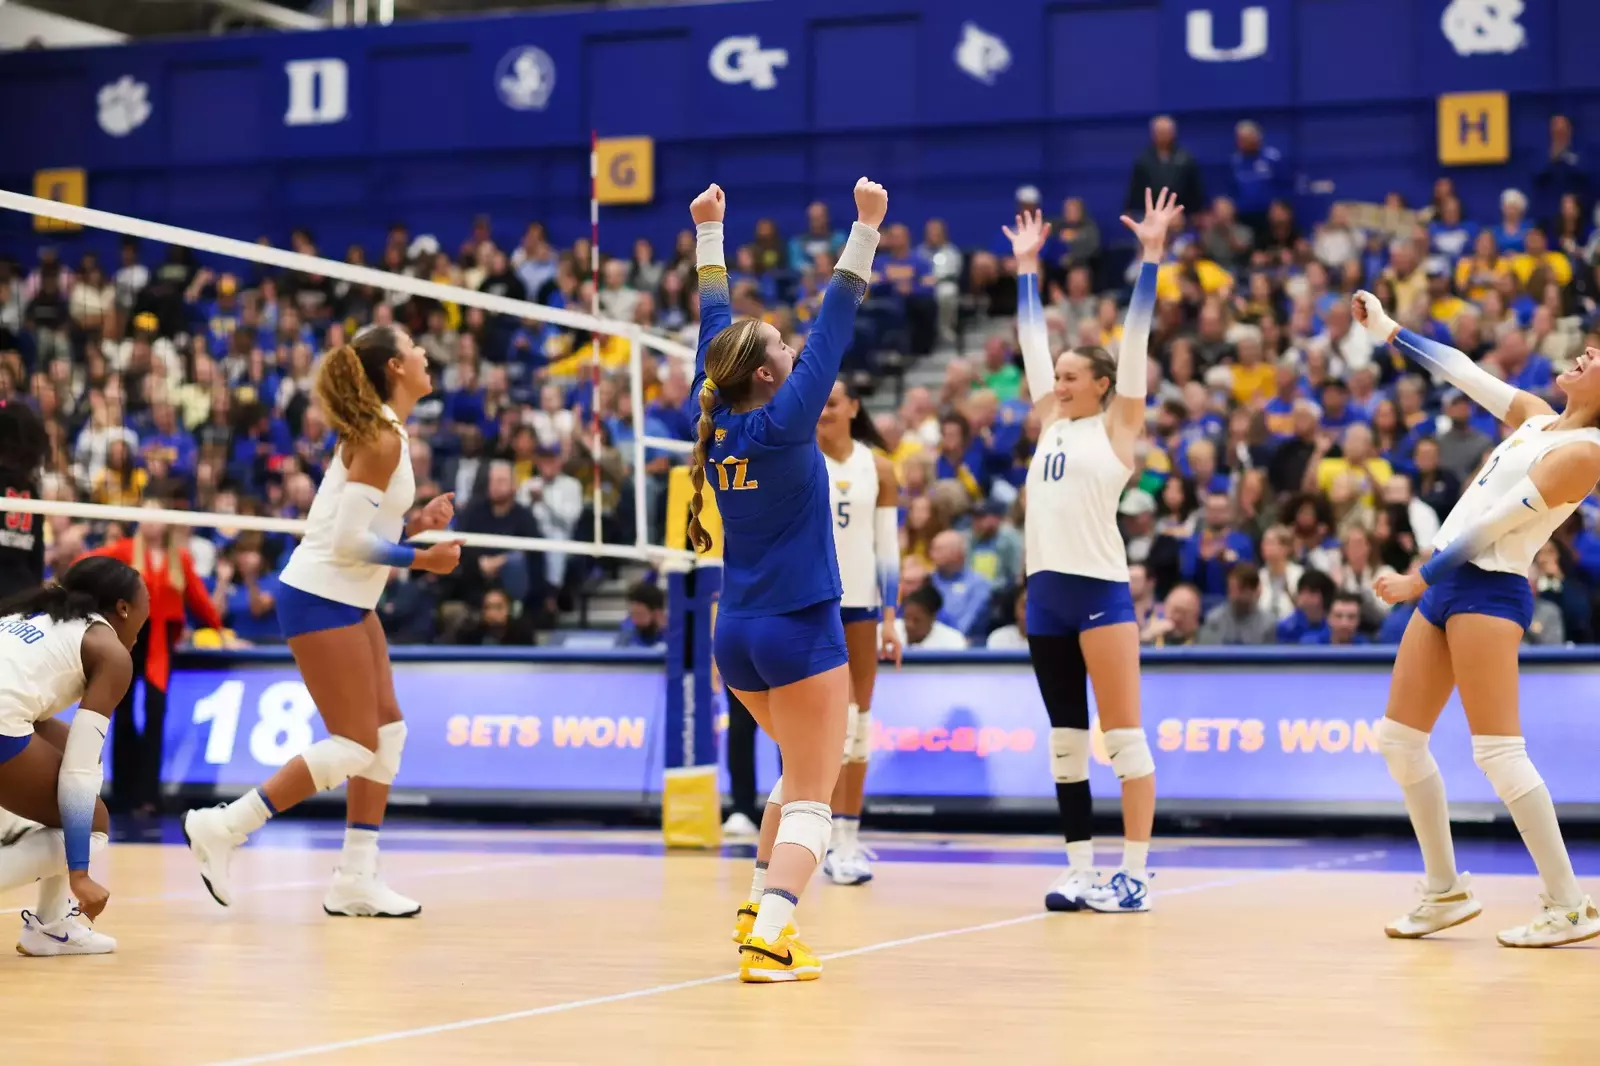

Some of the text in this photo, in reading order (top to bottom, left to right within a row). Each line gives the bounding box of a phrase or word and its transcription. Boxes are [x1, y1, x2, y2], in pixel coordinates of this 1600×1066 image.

[1185, 6, 1269, 62] U
[283, 58, 348, 127] D
[1458, 111, 1489, 146] H
[608, 152, 637, 189] G
[708, 455, 758, 490] 12
[1043, 452, 1065, 482] 10
[1478, 456, 1500, 486] 2
[837, 502, 850, 528] 5
[192, 680, 317, 766] 18
[447, 714, 645, 748] SETS WON
[869, 720, 1036, 757] kscape
[1157, 718, 1380, 753] SETS WON
